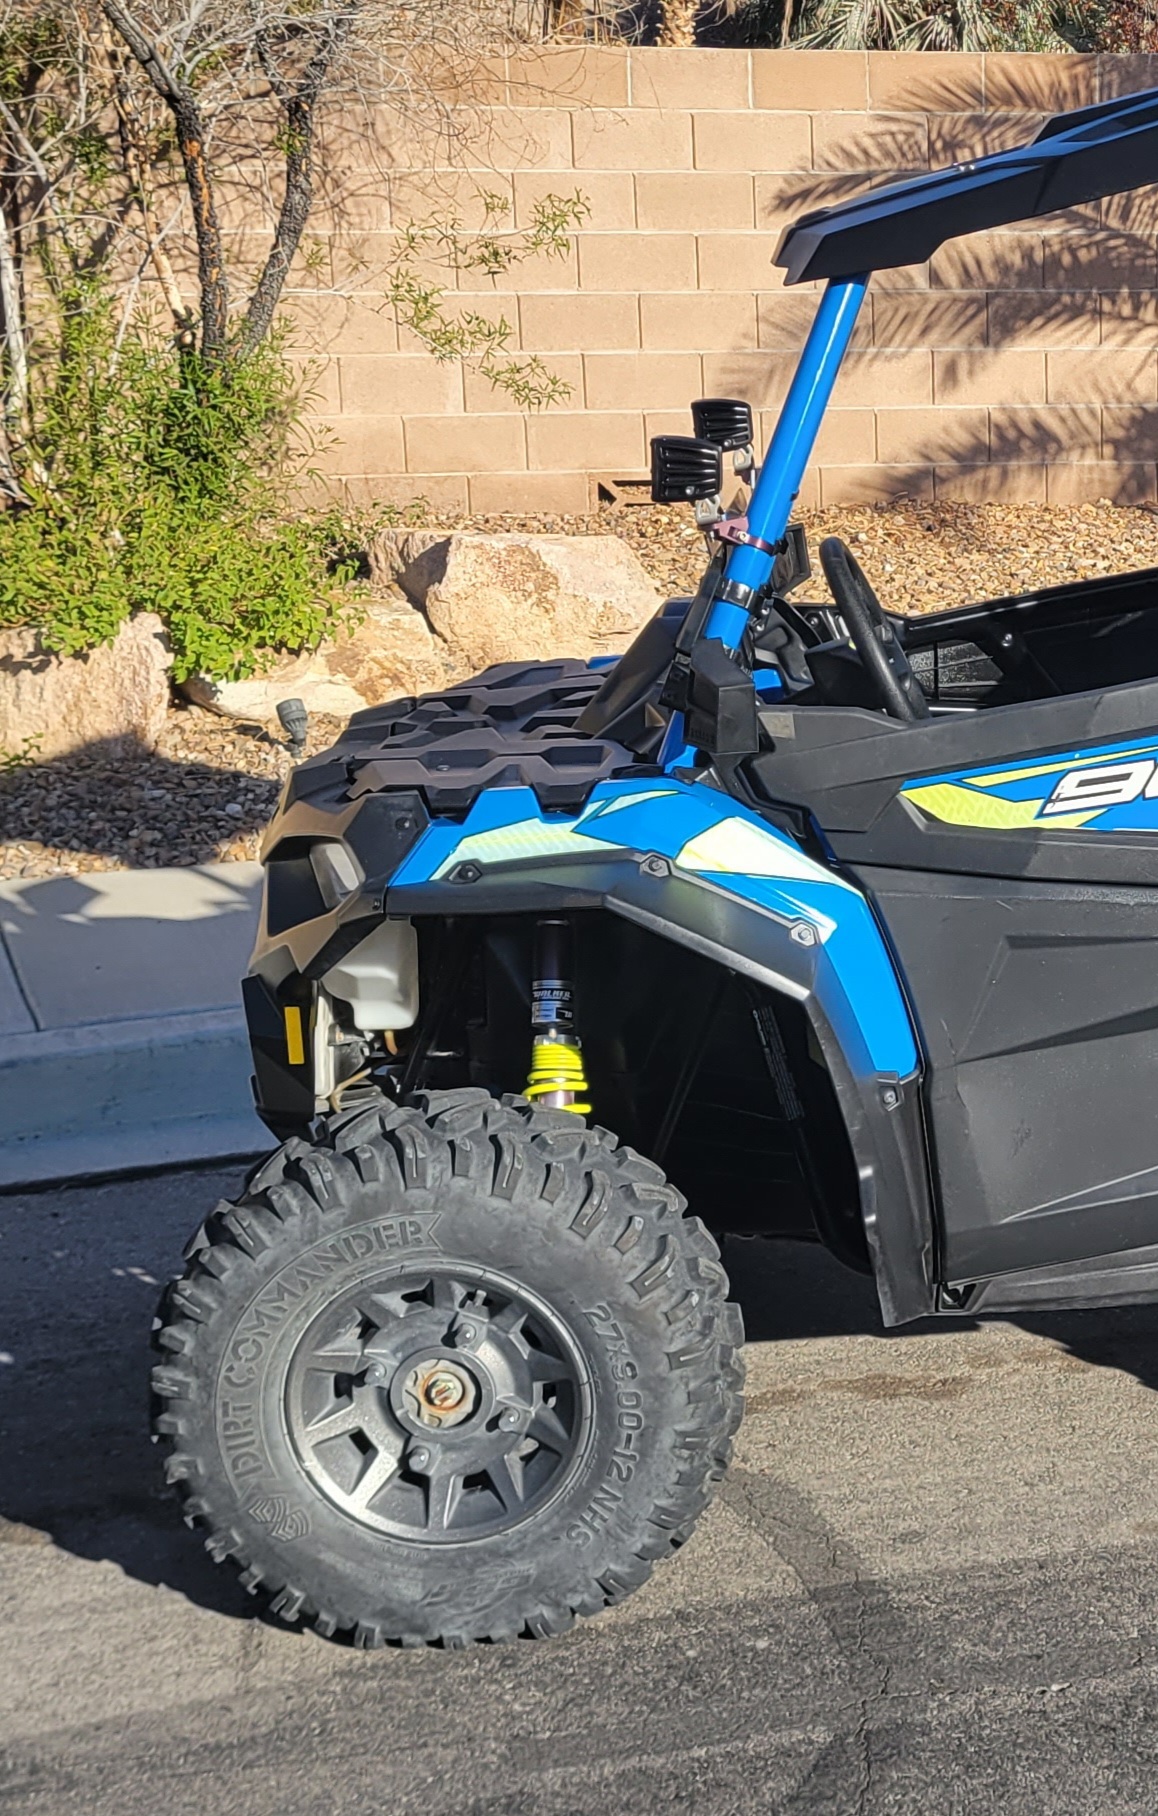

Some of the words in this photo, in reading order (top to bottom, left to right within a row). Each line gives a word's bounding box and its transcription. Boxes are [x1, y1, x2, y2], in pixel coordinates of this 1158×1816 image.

[223, 1219, 424, 1389] COMMANDER
[221, 1400, 264, 1478] DIRT
[566, 1484, 623, 1547] NHS
